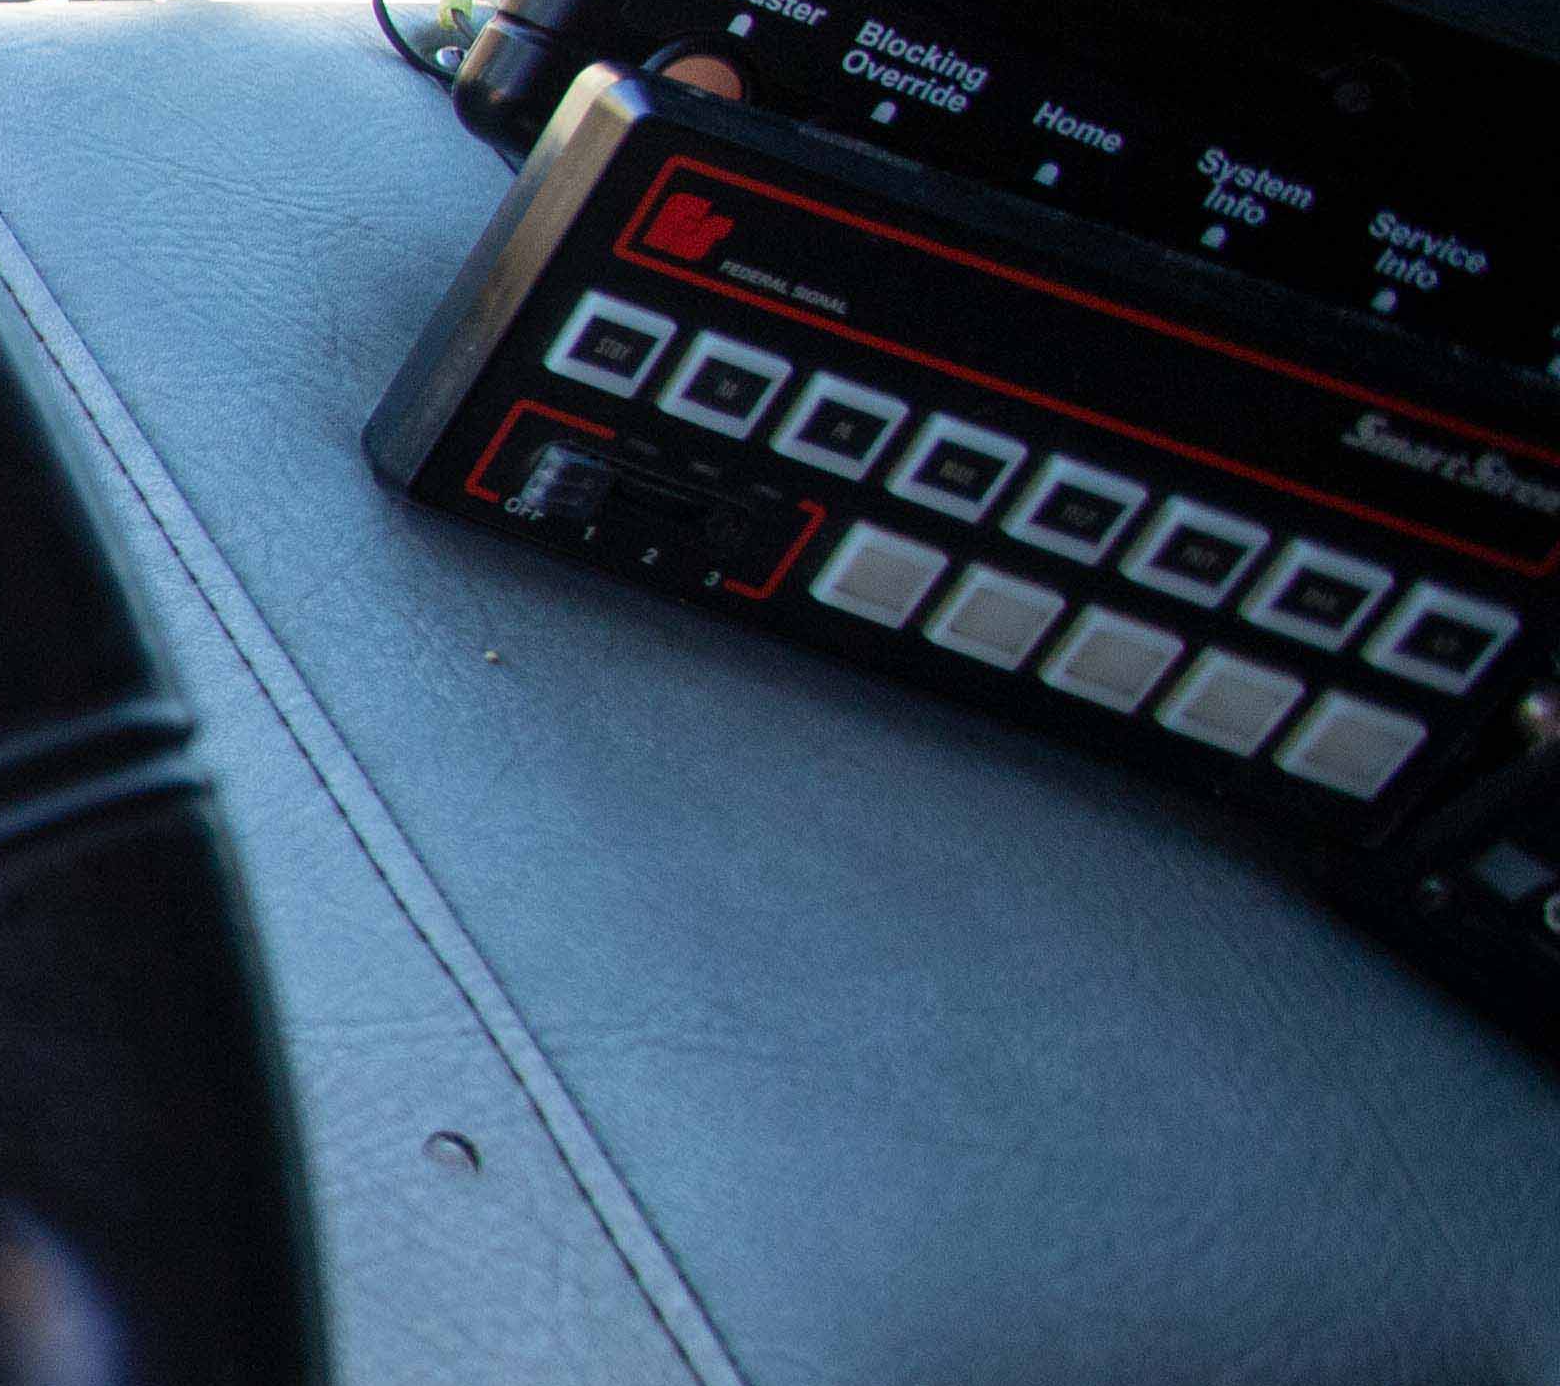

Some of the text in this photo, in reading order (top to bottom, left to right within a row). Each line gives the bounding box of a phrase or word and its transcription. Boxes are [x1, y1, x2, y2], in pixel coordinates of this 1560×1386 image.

[841, 48, 969, 115] Override
[854, 18, 989, 94] Blocking
[1032, 101, 1125, 154] Home
[1196, 146, 1315, 211] System
[1203, 178, 1268, 227] Info
[1366, 210, 1490, 275] Service
[1375, 247, 1441, 291] Info
[720, 259, 851, 316] FEDERAL SIGNAL
[584, 526, 597, 540] 1
[641, 547, 660, 564] 2
[704, 571, 720, 587] 3
